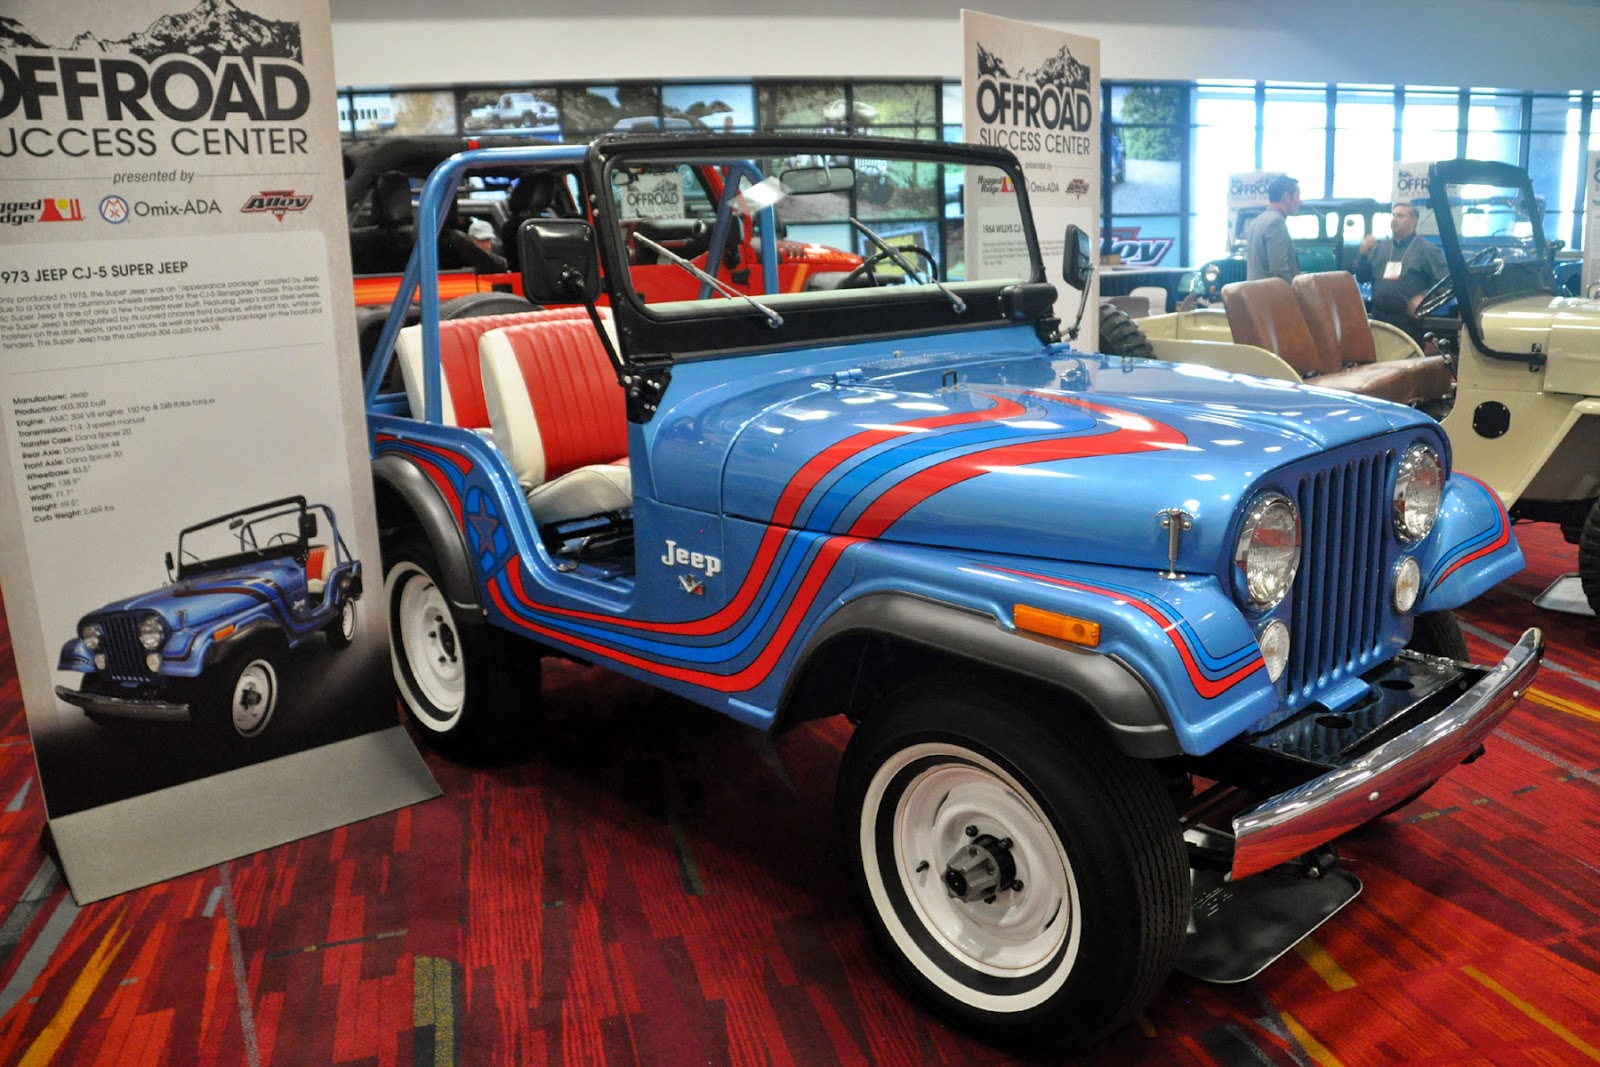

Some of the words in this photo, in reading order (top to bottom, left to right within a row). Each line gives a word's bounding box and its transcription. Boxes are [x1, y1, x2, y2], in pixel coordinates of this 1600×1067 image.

[976, 80, 1092, 132] OFFROAD
[0, 128, 156, 157] UCCESS
[170, 128, 308, 156] CENTER
[980, 128, 1041, 152] SUCCESS
[1045, 134, 1090, 155] CENTER
[113, 172, 176, 185] presented
[180, 170, 195, 183] by
[978, 175, 1002, 185] Rugged
[1398, 178, 1430, 190] OFFR
[981, 184, 999, 194] Ridge
[1230, 184, 1267, 195] OFFRO
[245, 196, 309, 209] Alloy
[626, 192, 678, 206] OFFROAD
[134, 199, 222, 217] Omix-ADA
[34, 268, 68, 282] JEEP
[72, 266, 107, 280] CJ-5
[111, 262, 154, 277] SUPER
[158, 261, 188, 274] JEEP
[92, 419, 115, 428] speed
[117, 416, 145, 425] manual
[20, 438, 49, 448] Transfer
[86, 443, 108, 451] Spicer
[24, 462, 43, 470] Front
[89, 453, 111, 461] Spicer
[662, 540, 721, 577] Jeep
